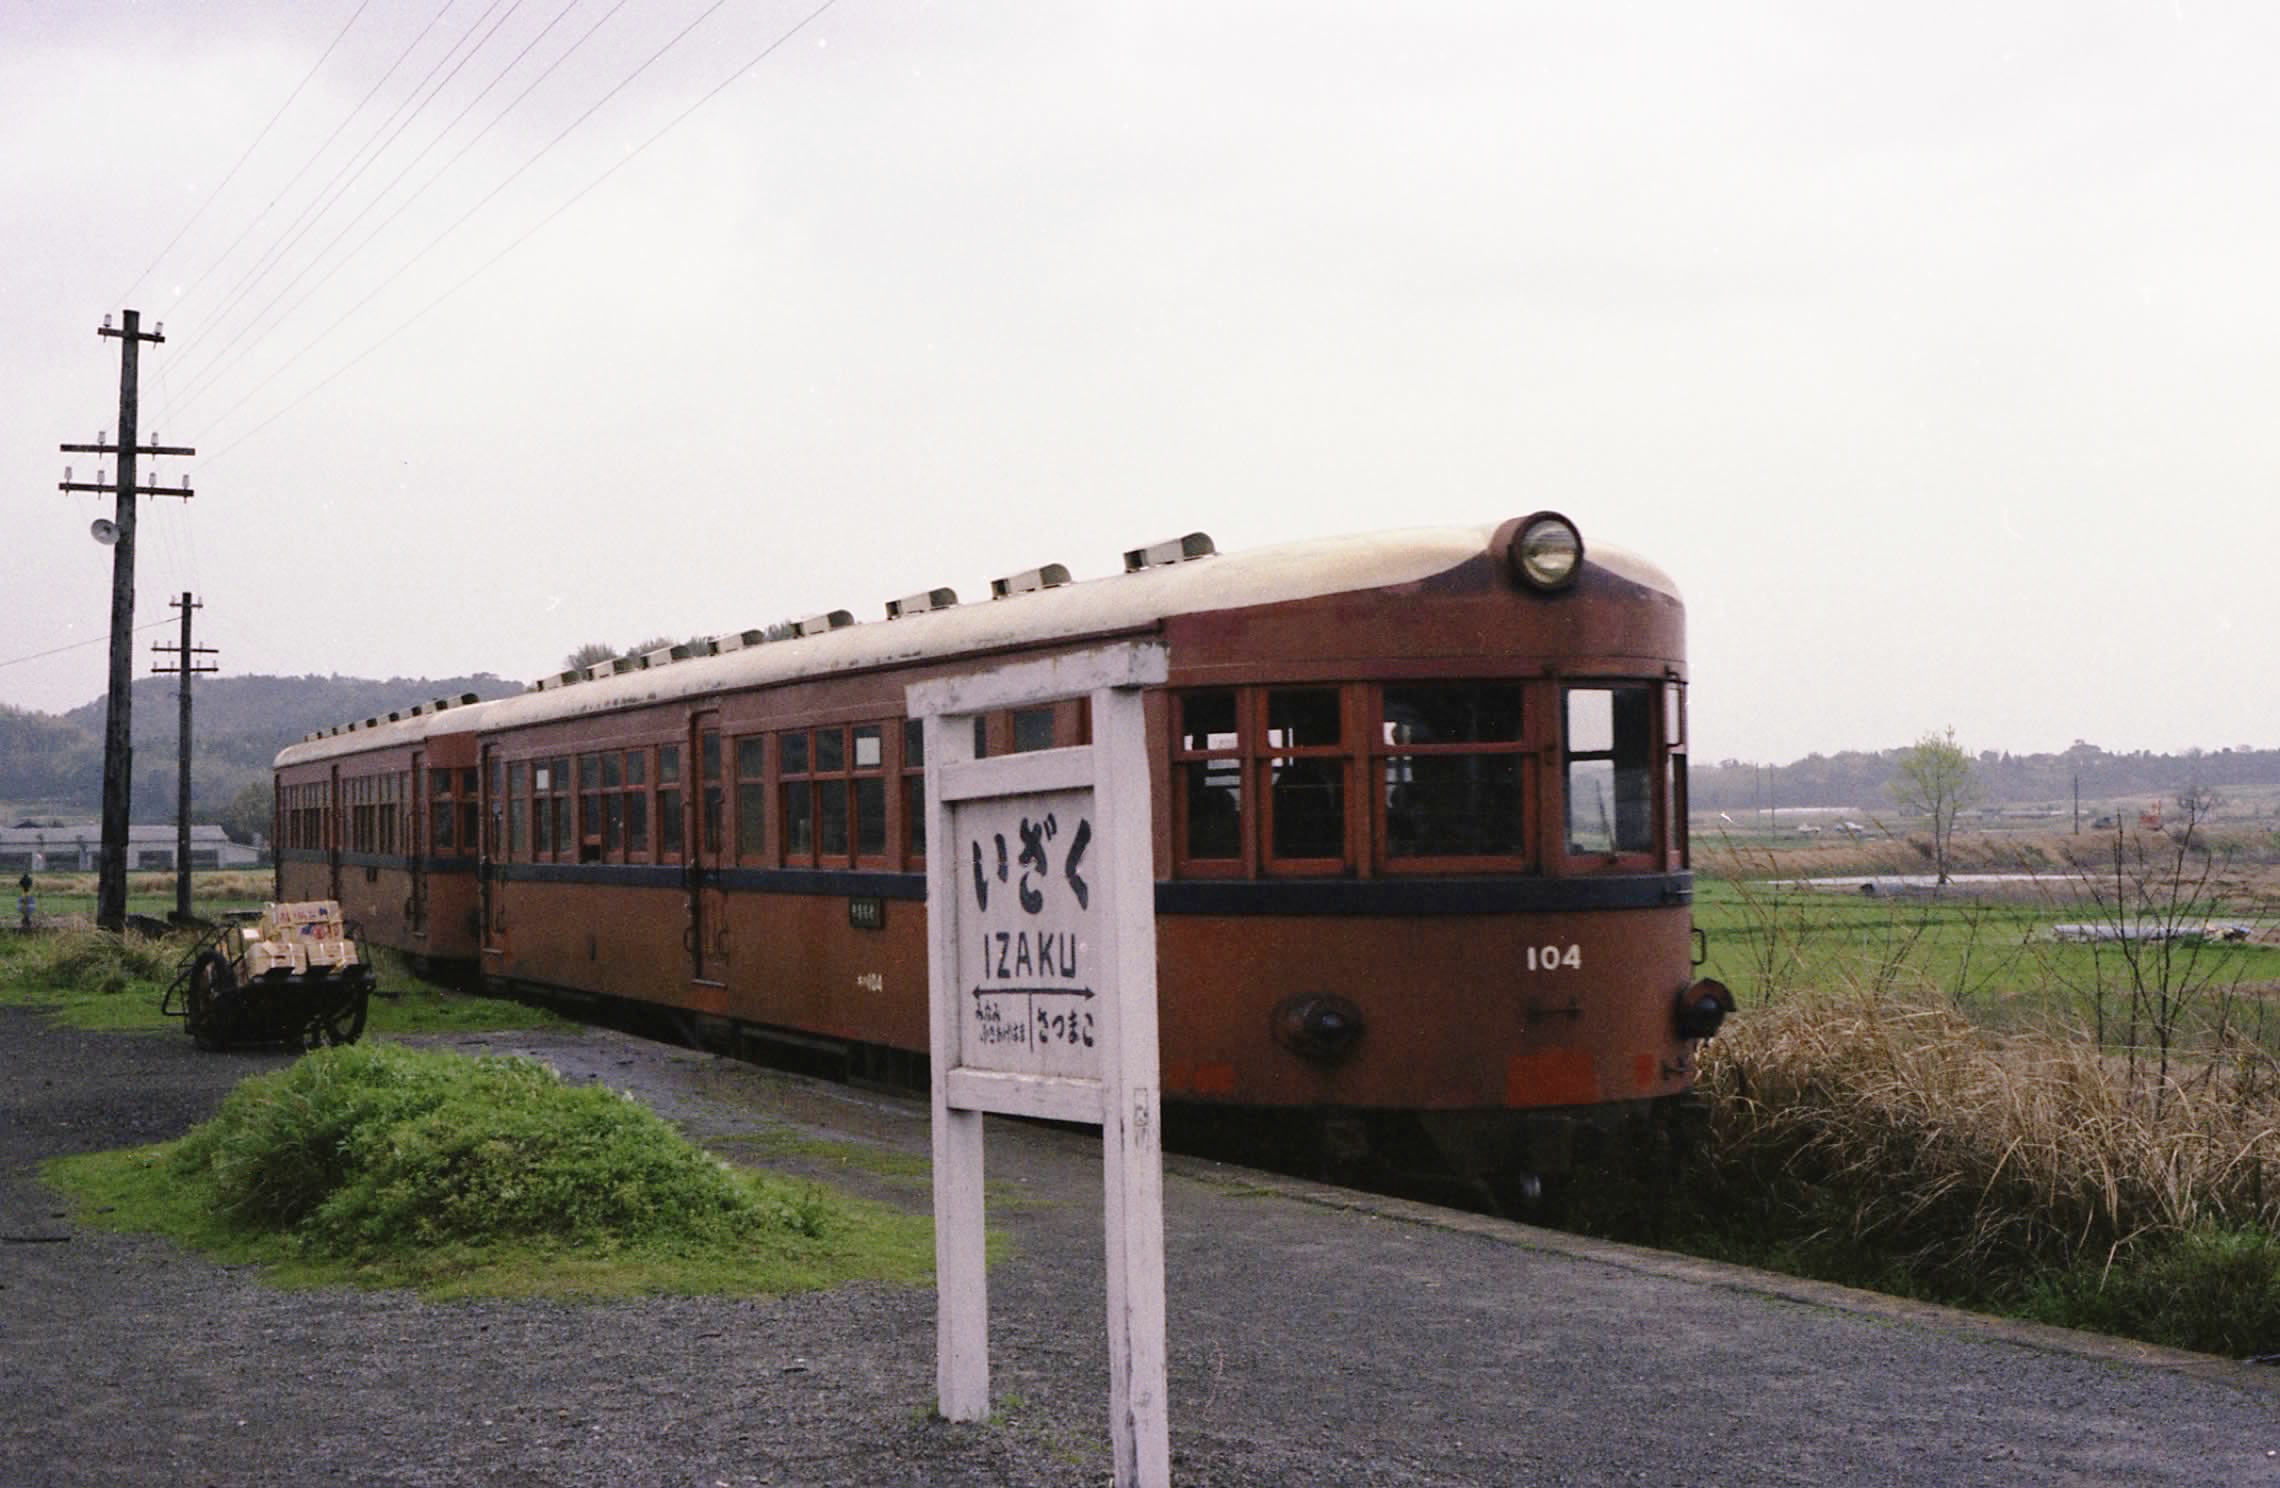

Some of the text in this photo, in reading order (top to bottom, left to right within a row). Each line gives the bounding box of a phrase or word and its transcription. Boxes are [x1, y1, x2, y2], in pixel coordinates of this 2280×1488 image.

[972, 813, 1091, 914] いざく
[984, 931, 1076, 979] IZAKU
[1527, 944, 1582, 971] 104
[1037, 1008, 1094, 1047] さつまこ
